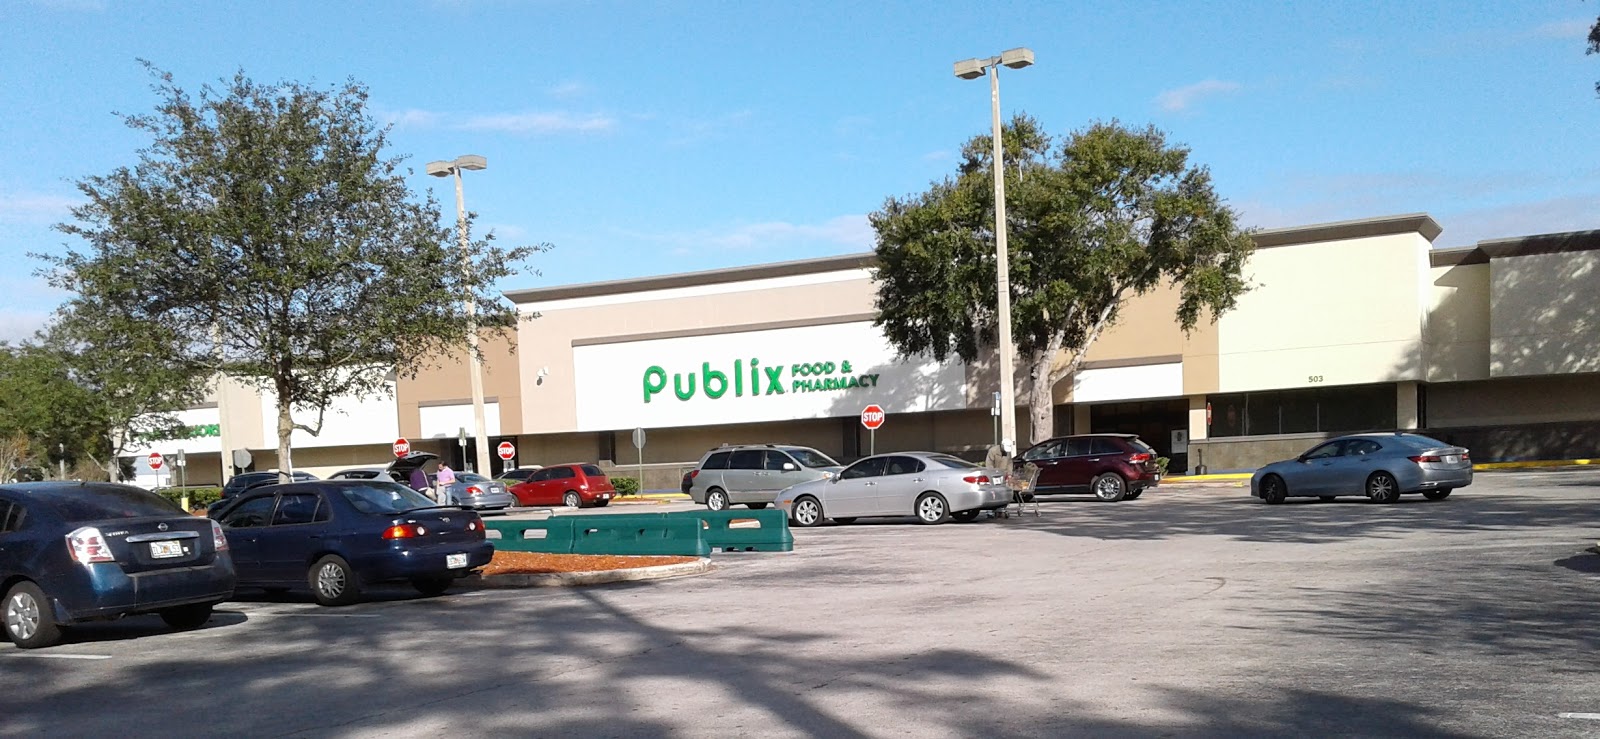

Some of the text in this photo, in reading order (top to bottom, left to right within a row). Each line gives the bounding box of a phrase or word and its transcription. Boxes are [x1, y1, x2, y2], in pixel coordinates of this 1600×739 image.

[792, 360, 852, 377] FOOD &
[792, 374, 880, 393] PHARMACY
[1308, 375, 1324, 383] 503
[863, 412, 883, 422] STOP
[394, 444, 408, 452] STOP
